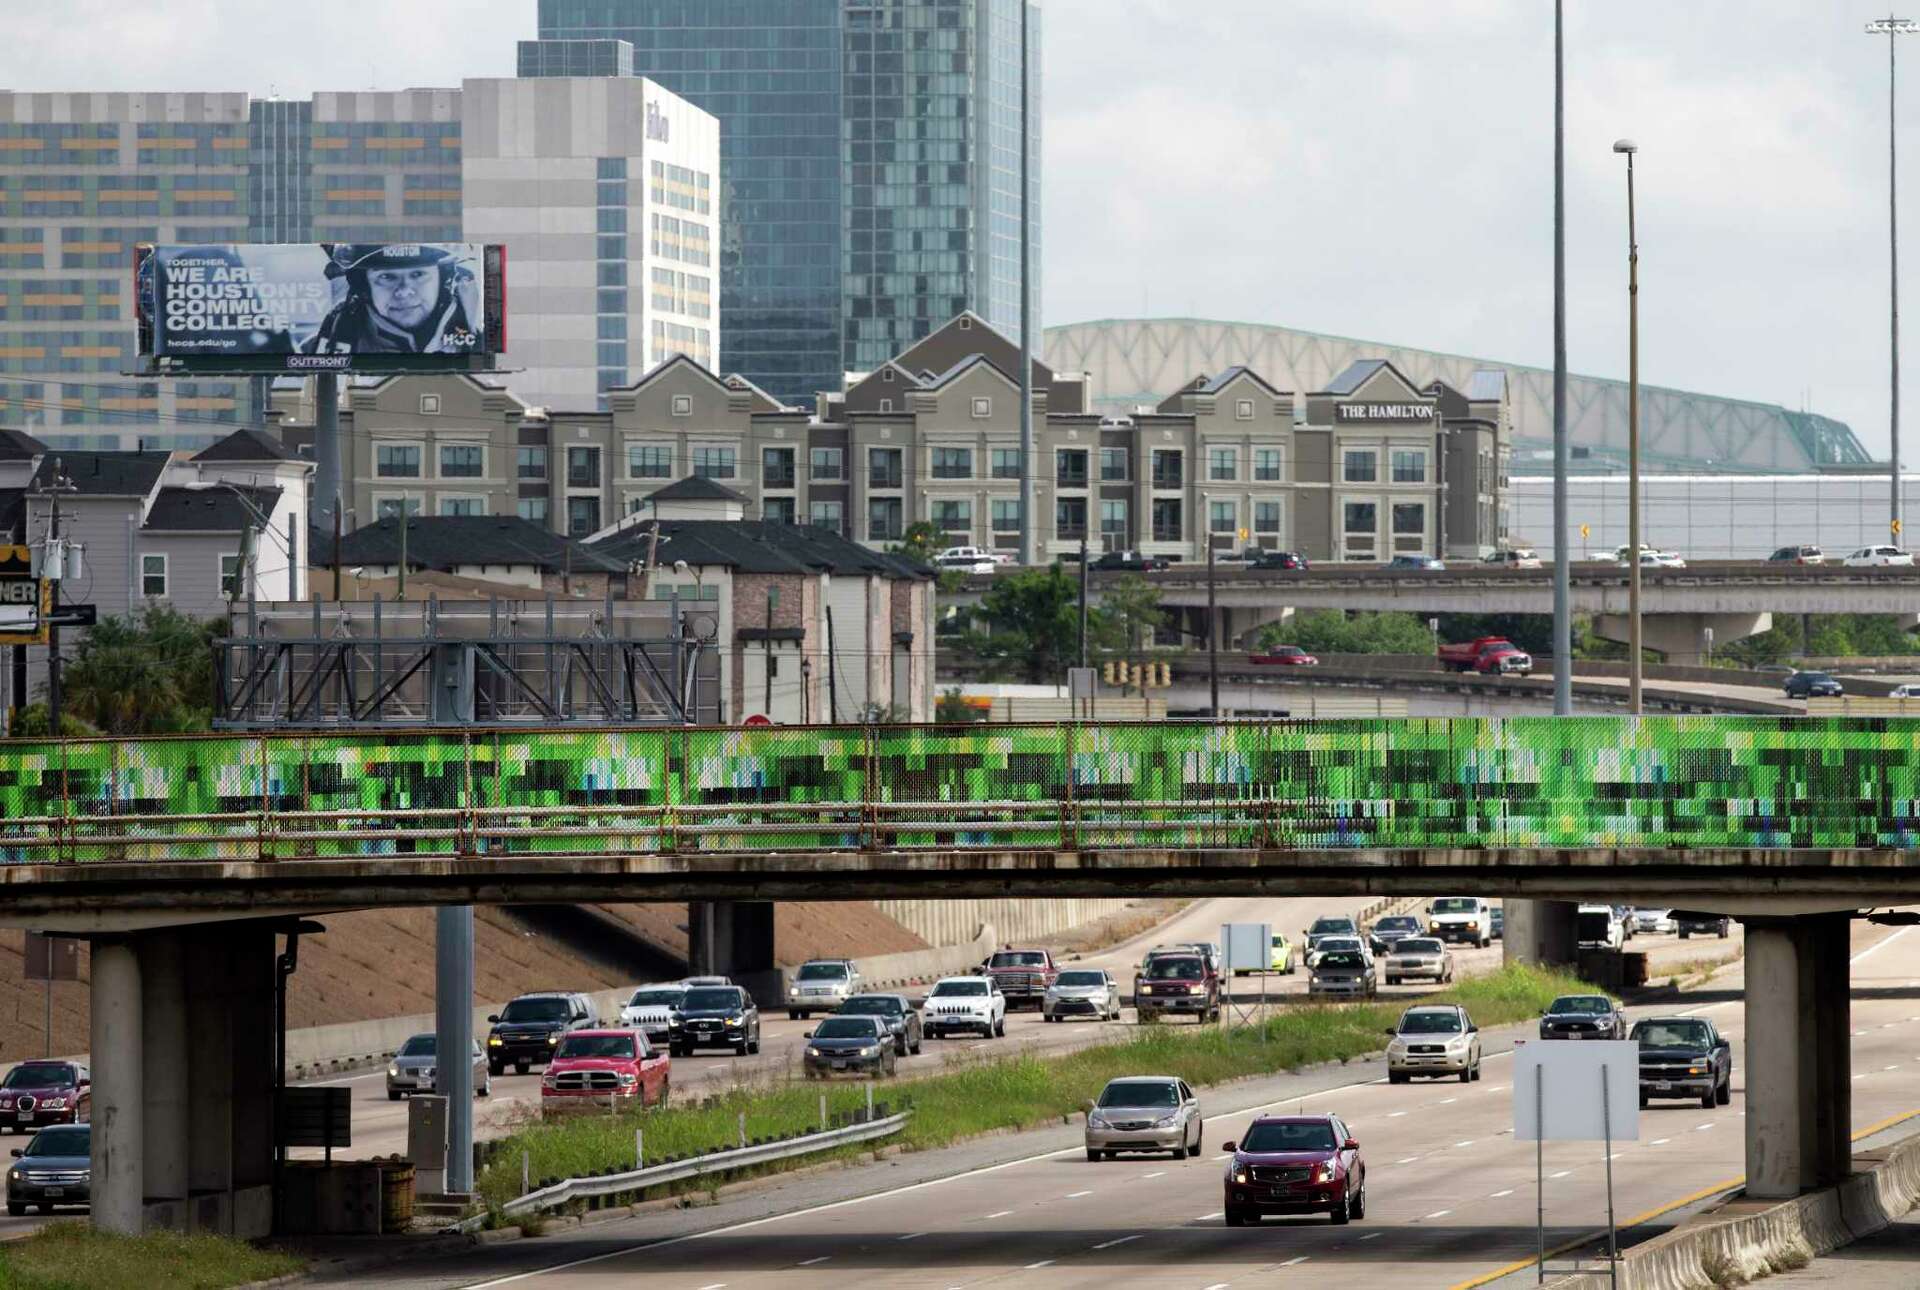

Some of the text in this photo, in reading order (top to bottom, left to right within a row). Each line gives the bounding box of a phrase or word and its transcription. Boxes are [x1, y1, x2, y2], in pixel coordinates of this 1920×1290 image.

[383, 246, 420, 257] HOUSTON
[167, 258, 228, 267] TOGETHER,
[166, 267, 265, 283] WE ARE
[166, 282, 322, 299] HOUSTON'S
[166, 299, 327, 315] COMMUNITY
[166, 315, 297, 332] COLLEGE.
[443, 334, 476, 346] HCC
[290, 357, 349, 368] OUTFRONT
[1340, 404, 1433, 418] THE HAMILTON
